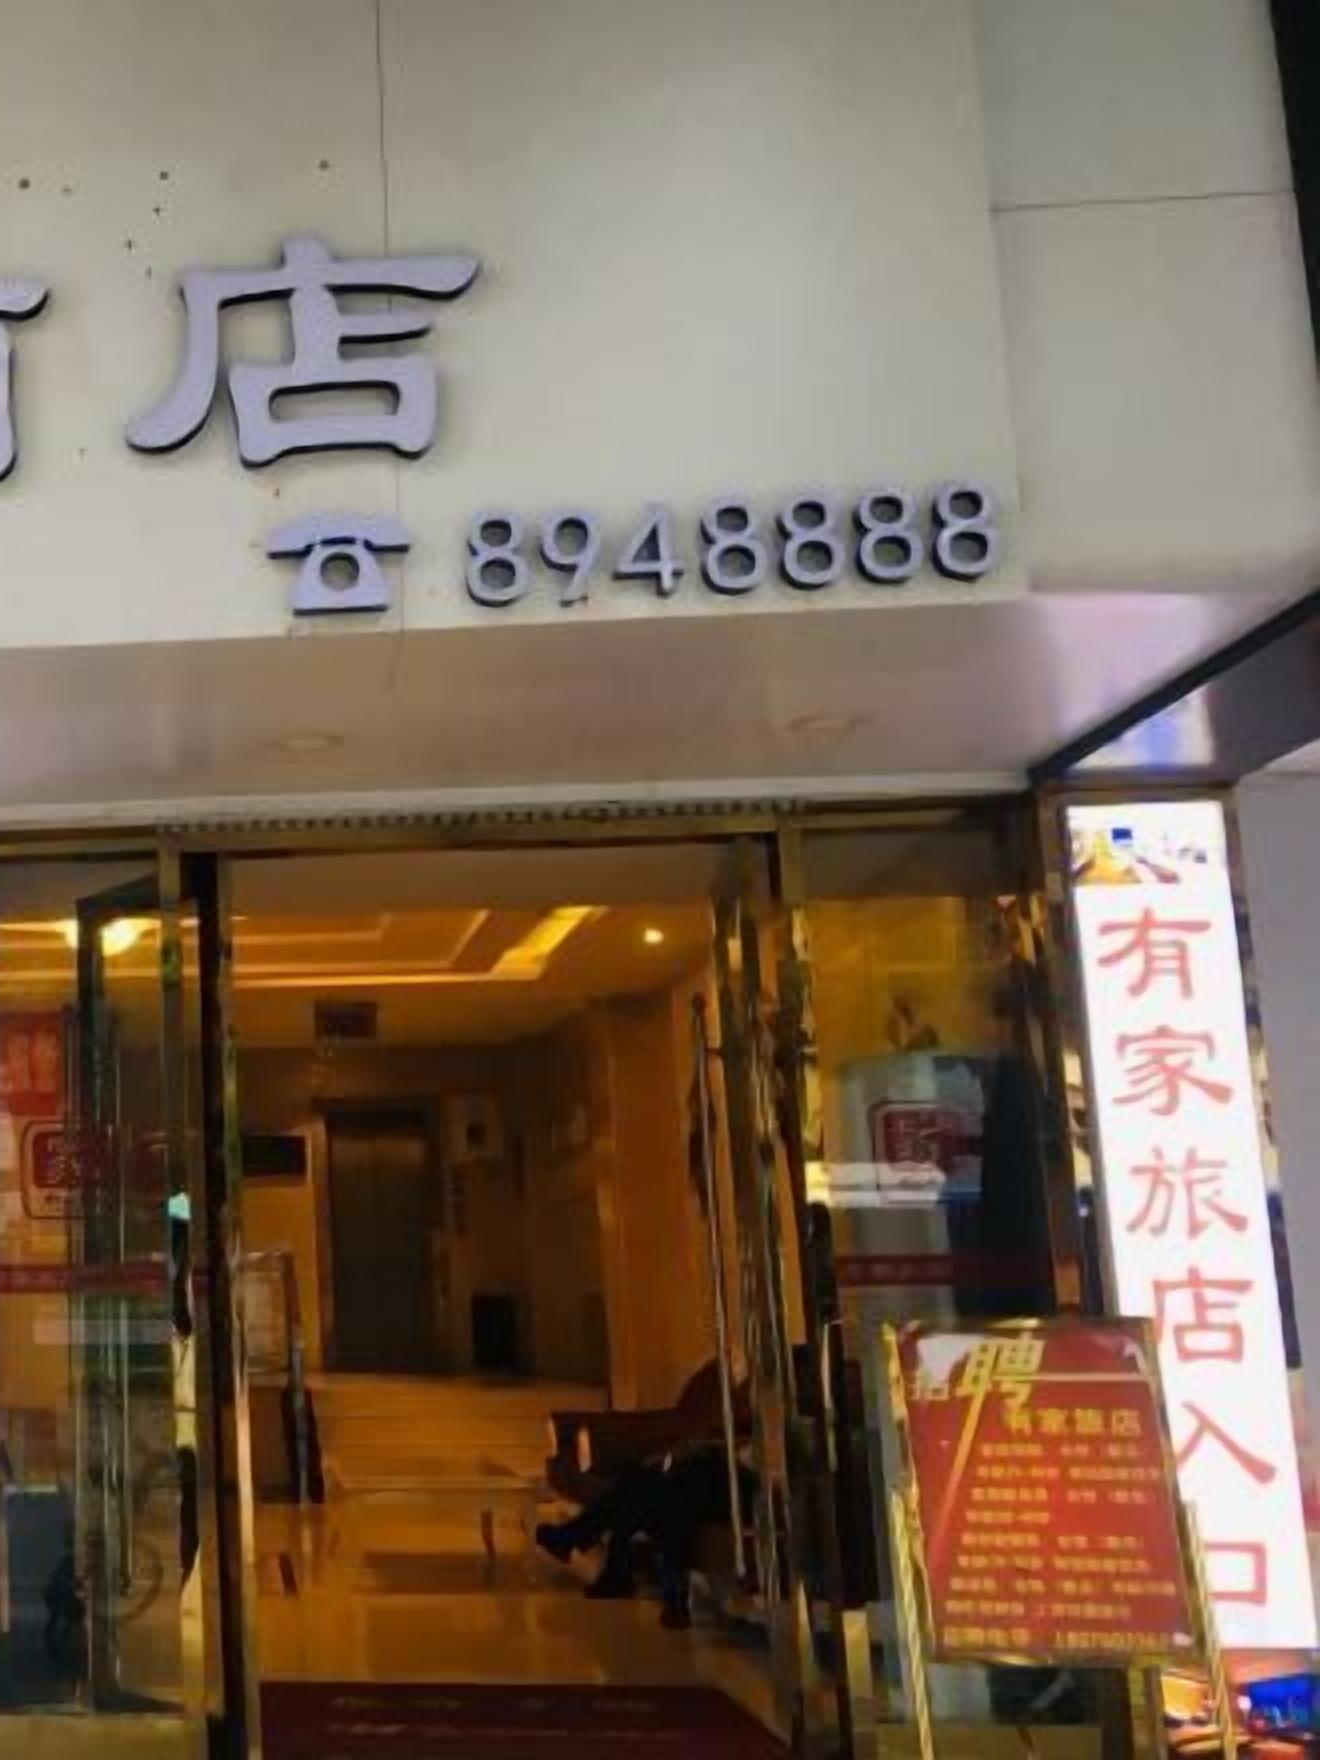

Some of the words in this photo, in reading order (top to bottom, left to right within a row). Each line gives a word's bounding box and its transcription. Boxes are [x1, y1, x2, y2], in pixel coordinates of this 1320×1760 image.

[465, 484, 1003, 607] 8948888
[1096, 905, 1279, 1608] 有家旅店入口
